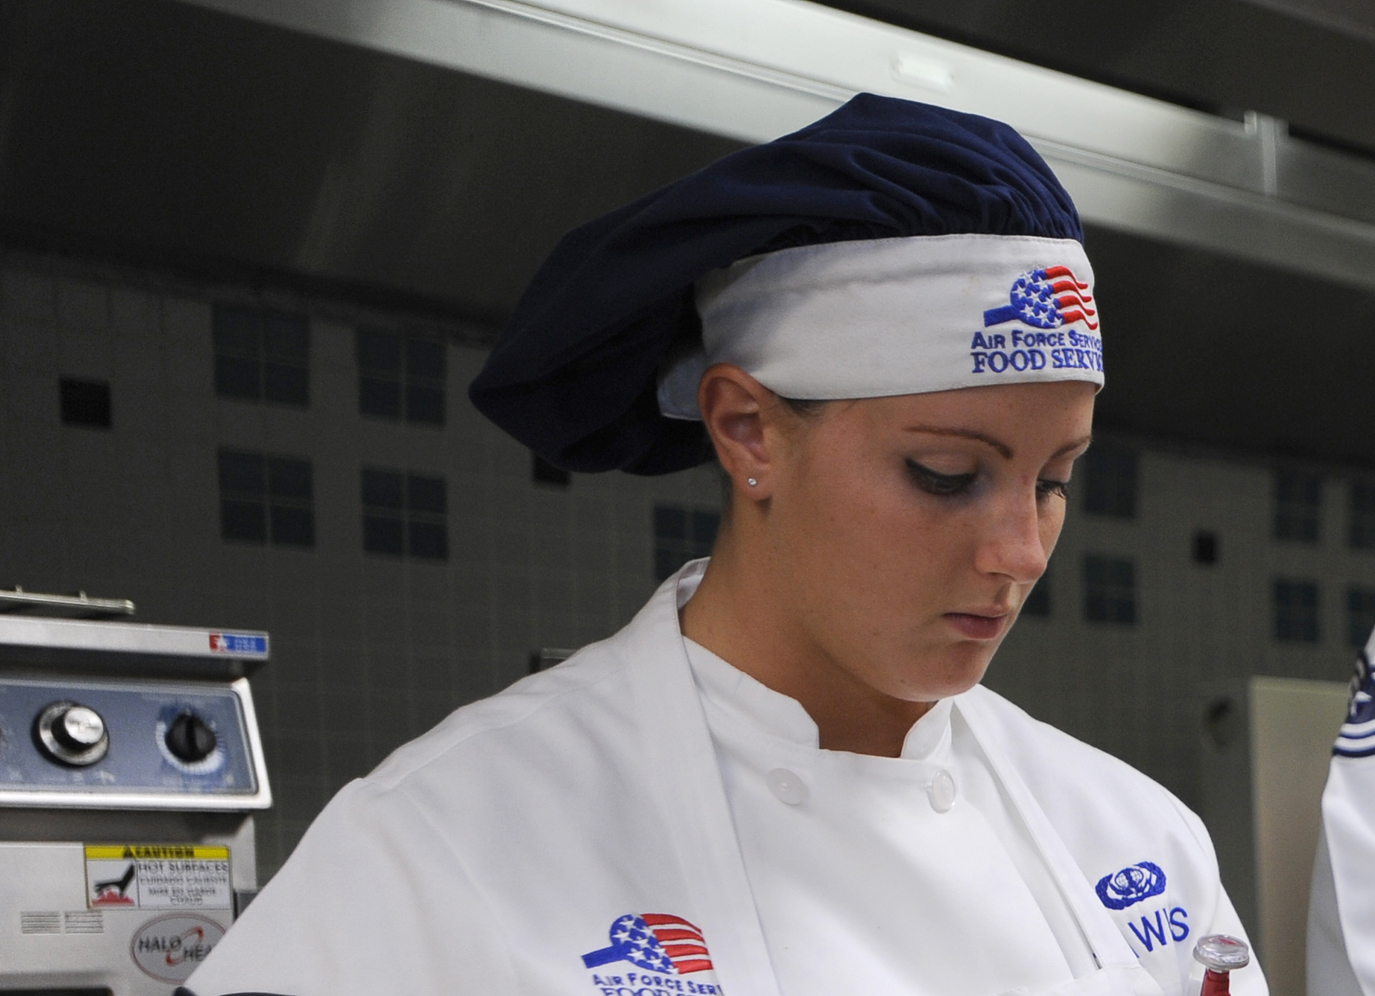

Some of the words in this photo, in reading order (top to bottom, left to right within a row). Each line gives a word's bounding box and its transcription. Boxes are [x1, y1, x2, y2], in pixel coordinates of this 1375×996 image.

[970, 348, 1047, 373] FOOD
[135, 845, 195, 858] CAUTION
[138, 862, 164, 875] HOT
[169, 861, 228, 875] SURFACES
[138, 935, 182, 953] HALO
